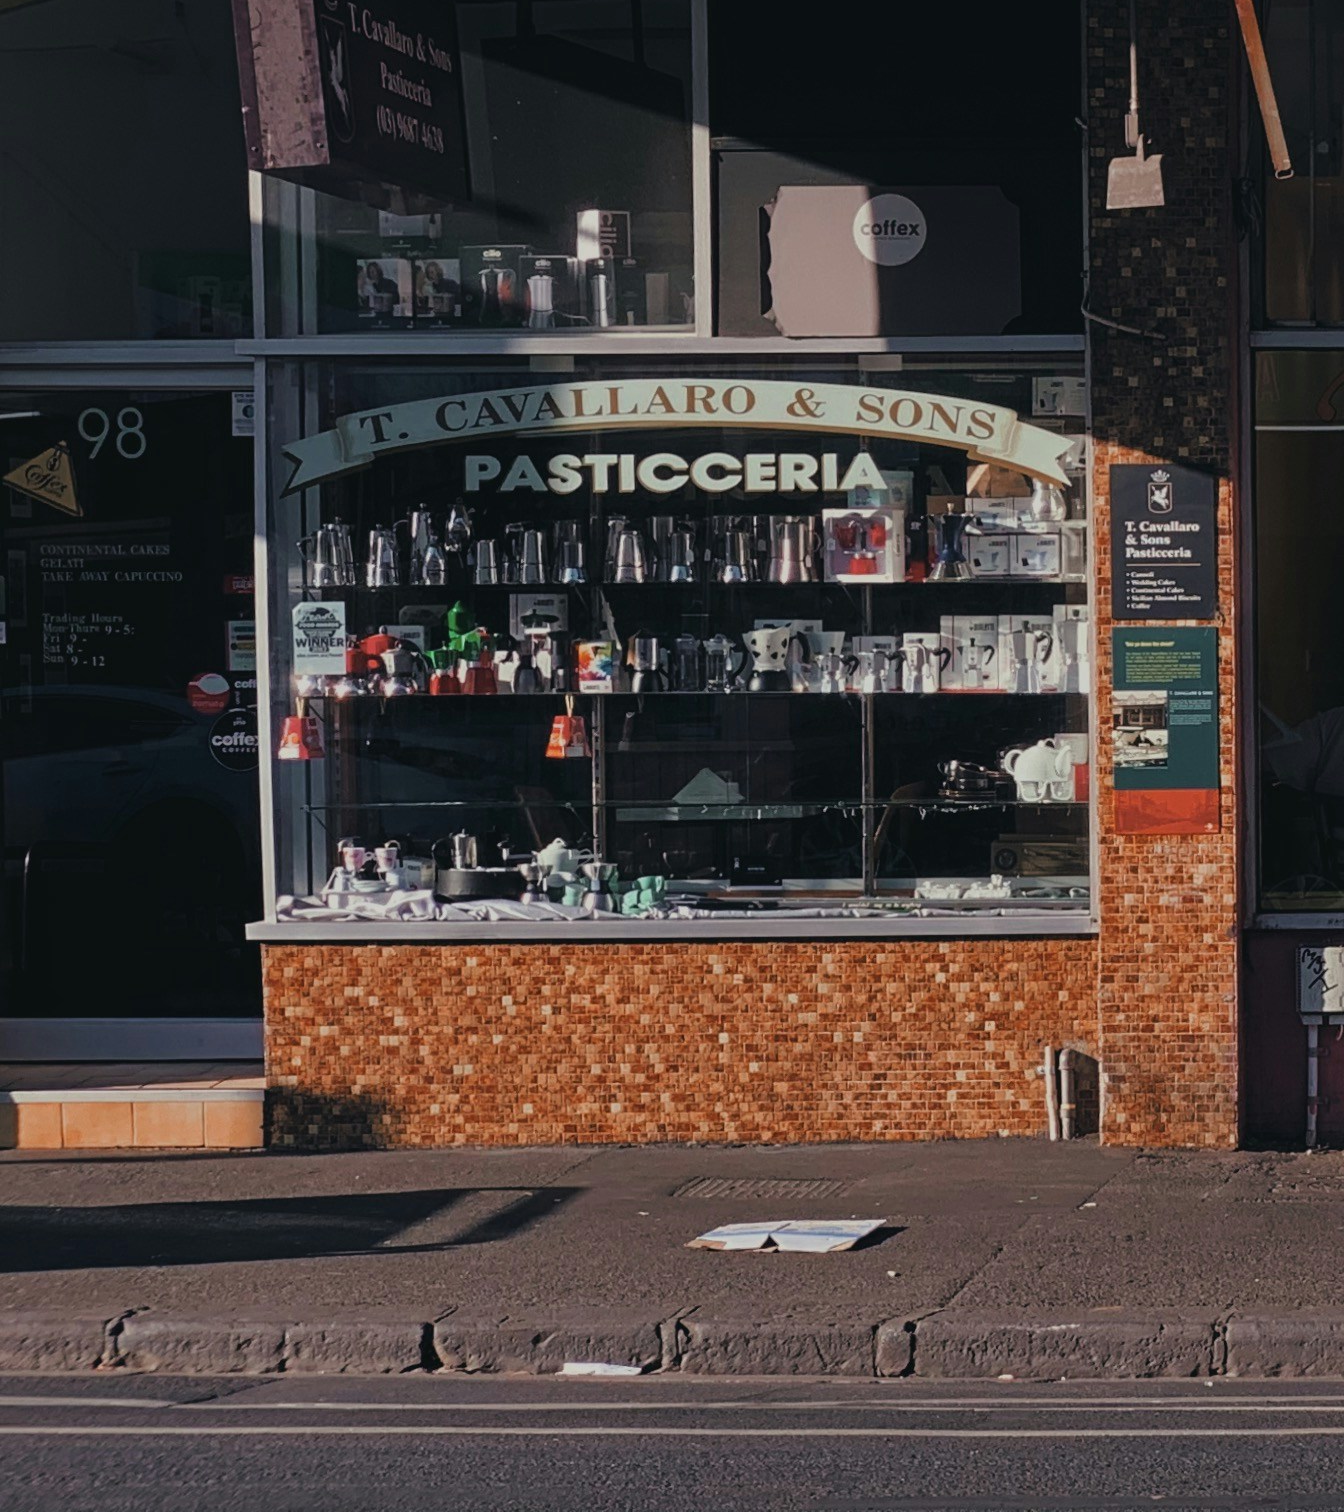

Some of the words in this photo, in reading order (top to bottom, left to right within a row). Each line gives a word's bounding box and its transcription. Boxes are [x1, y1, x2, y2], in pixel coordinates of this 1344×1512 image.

[347, 1, 361, 33] T.
[362, 8, 414, 58] Cavallaro
[416, 33, 427, 63] &
[428, 37, 453, 73] Sons
[380, 61, 432, 108] Pasticceria
[376, 104, 397, 141] (03)
[860, 219, 920, 237] coffex
[360, 411, 410, 444] T.
[435, 385, 757, 432] CAVALLARO
[786, 387, 826, 418] &
[856, 394, 996, 439] SONS
[78, 407, 146, 459] 98
[465, 452, 888, 494] PASTICCERIA
[1125, 521, 1137, 532] T.
[1139, 521, 1200, 532] Cavallaro
[1125, 534, 1138, 545] &
[1140, 534, 1171, 545] Sons
[40, 544, 125, 555] CONTINENTAL
[130, 544, 170, 555] CAKES
[1126, 547, 1192, 558] Pasticceria
[40, 558, 84, 568] GELATI
[41, 571, 74, 581] TAKE
[79, 571, 110, 581] AWAY
[43, 613, 85, 624] Trading
[92, 613, 123, 623] Hours
[105, 625, 112, 634] 9
[43, 633, 60, 643] Fri
[69, 635, 77, 644] 9
[296, 638, 344, 647] WINNER
[66, 644, 74, 654] 8
[43, 654, 64, 663] Sun
[71, 657, 78, 666] 9
[93, 656, 105, 666] 12
